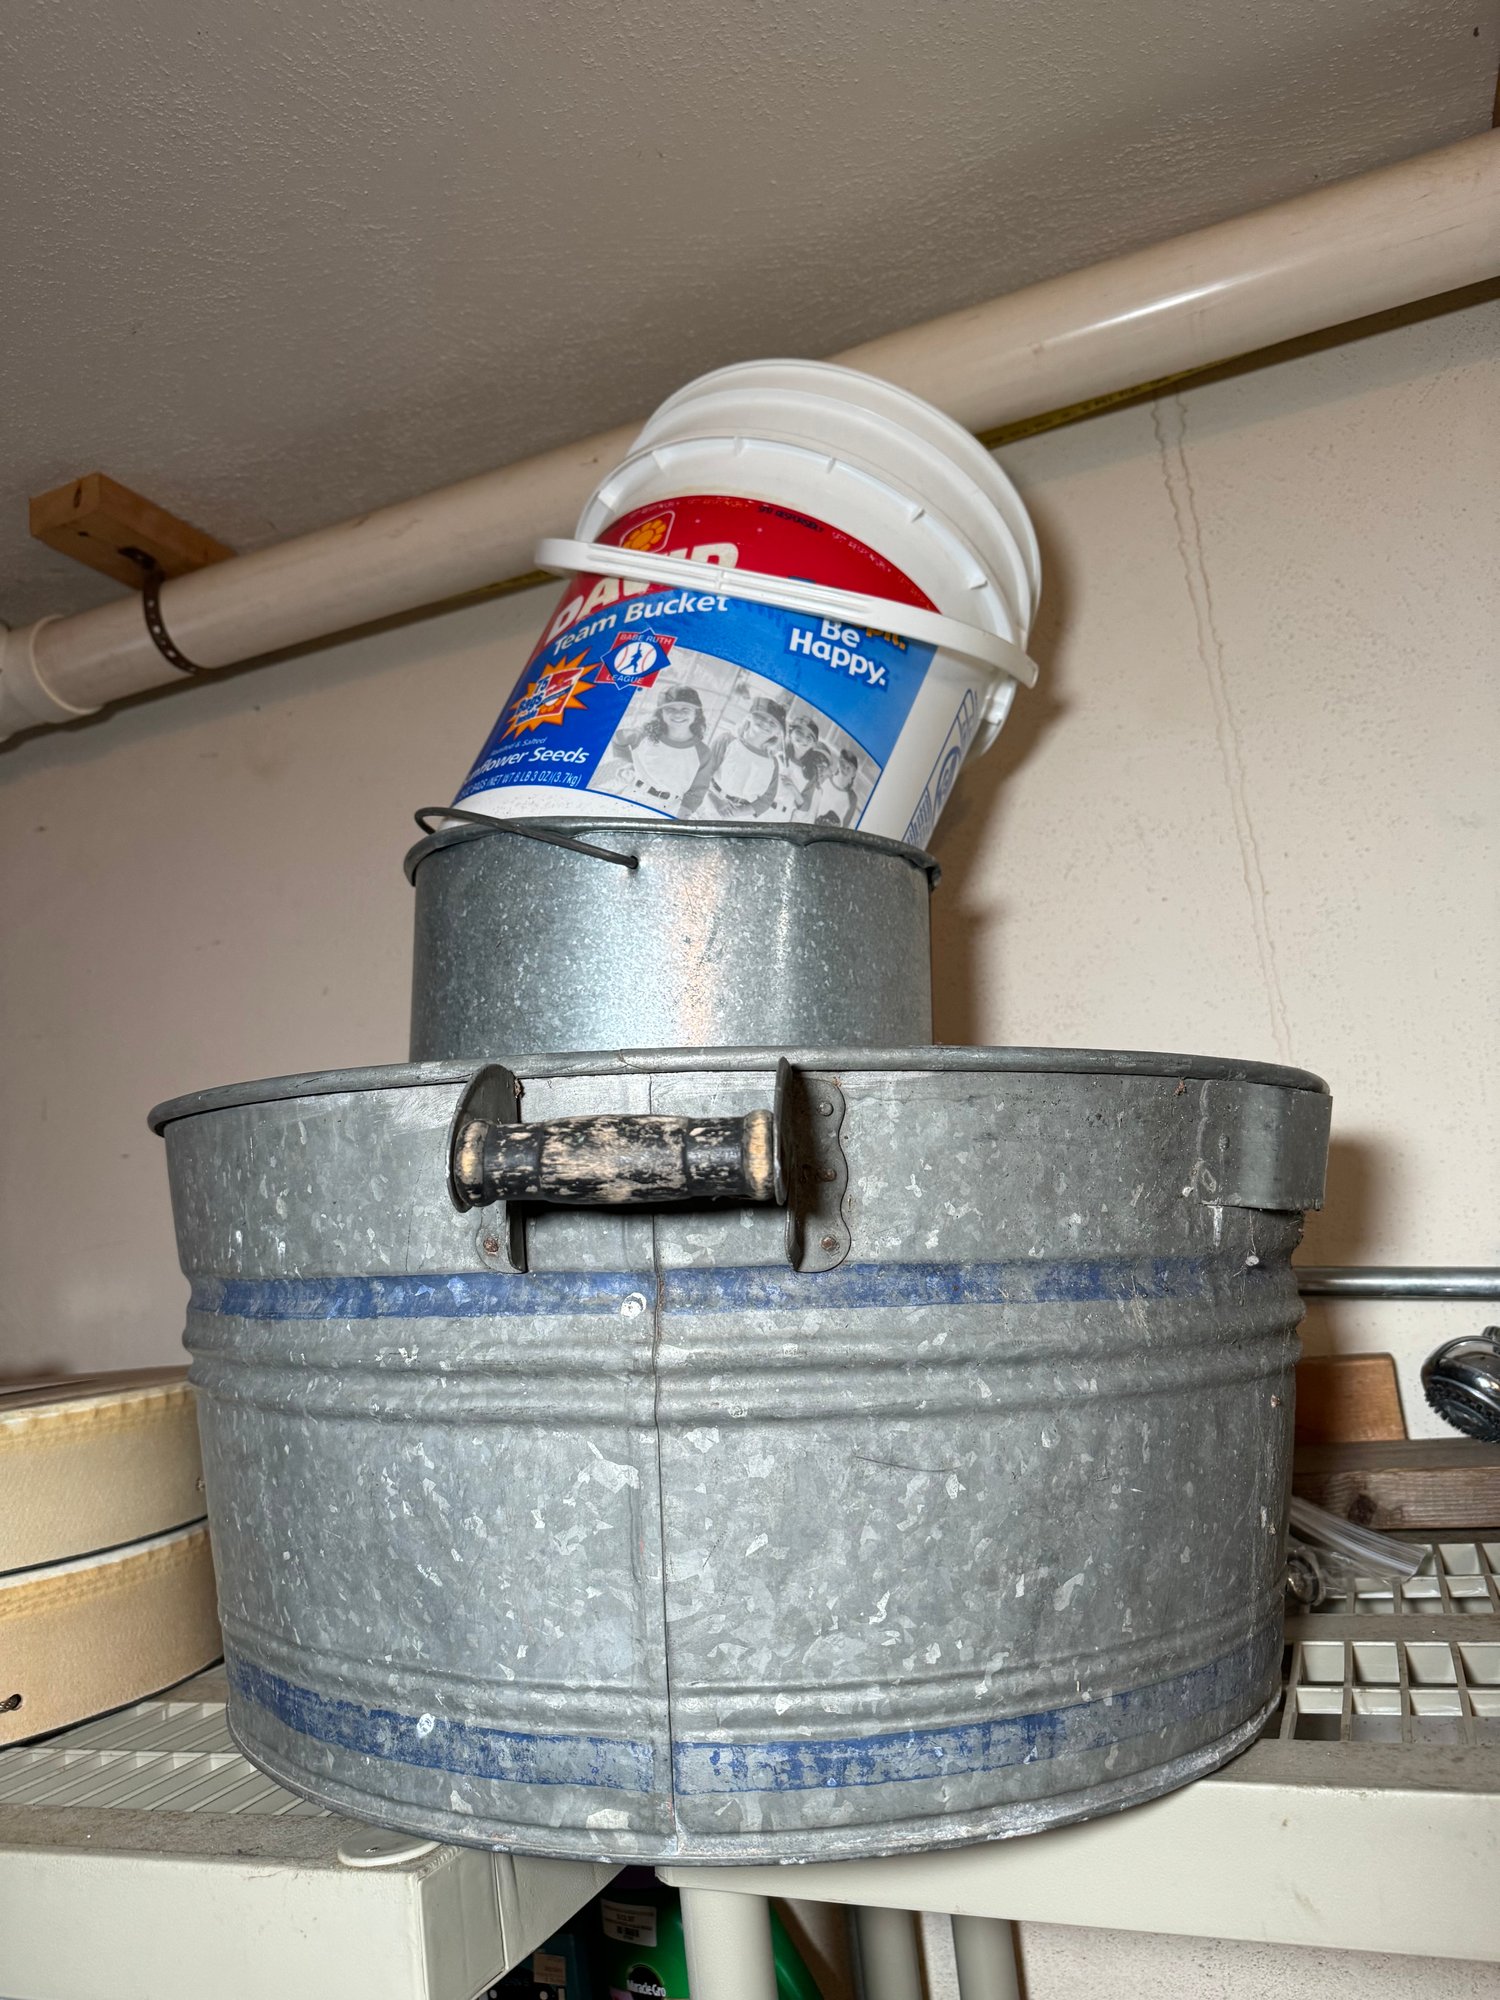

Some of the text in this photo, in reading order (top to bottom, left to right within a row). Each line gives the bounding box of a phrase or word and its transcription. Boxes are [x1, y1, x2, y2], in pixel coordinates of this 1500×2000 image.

[544, 542, 739, 646] DAD
[553, 592, 729, 656] Team Bucket
[821, 617, 860, 648] Be
[619, 633, 672, 645] BABE RUTH
[788, 627, 888, 687] Happy.
[606, 674, 645, 685] LEAGUE
[521, 736, 548, 747] Salted
[528, 746, 590, 764] Seeds
[520, 770, 533, 782] LB
[531, 770, 538, 782] 3
